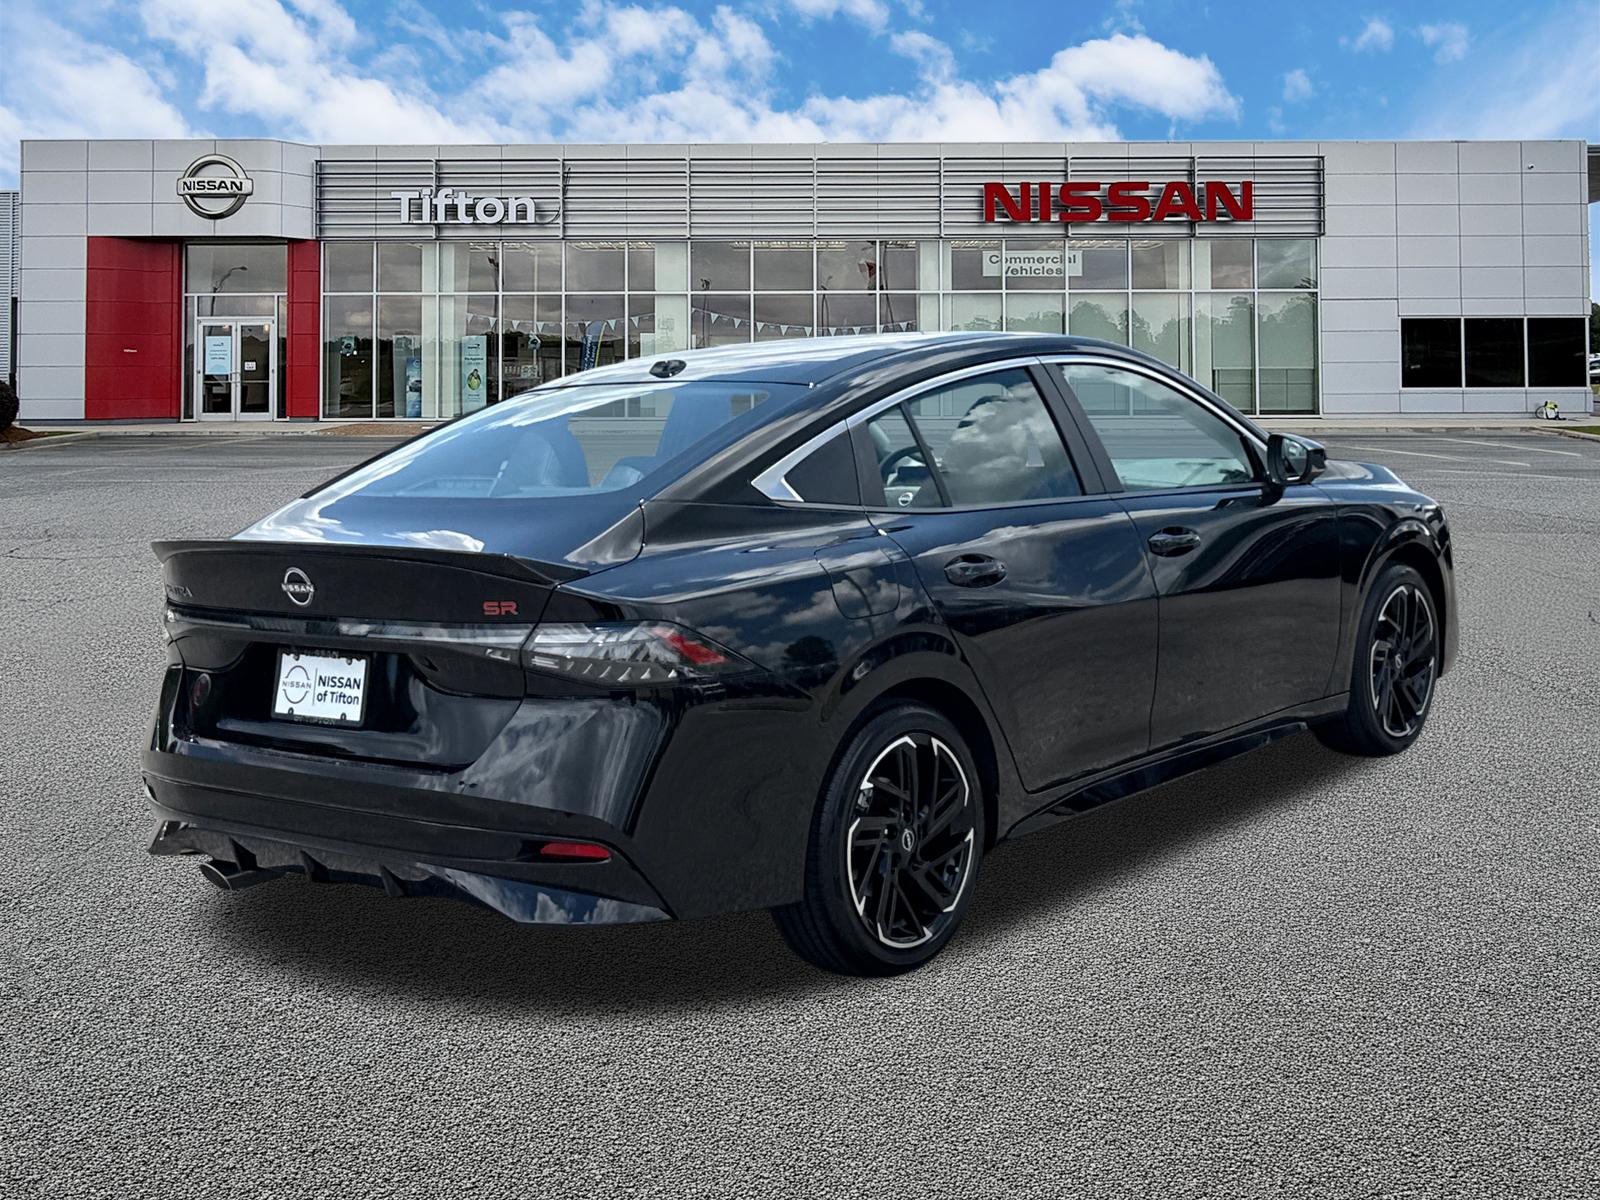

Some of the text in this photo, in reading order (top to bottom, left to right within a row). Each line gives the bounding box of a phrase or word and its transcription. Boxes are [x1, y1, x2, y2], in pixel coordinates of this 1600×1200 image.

[183, 181, 243, 191] NISSAN
[391, 188, 536, 223] Tifton
[984, 181, 1253, 222] NISSAN
[281, 583, 314, 593] NISSAN
[483, 601, 518, 615] SR
[282, 680, 312, 689] NISSAN
[318, 675, 361, 690] NISSAN
[316, 690, 360, 705] of Tifton
